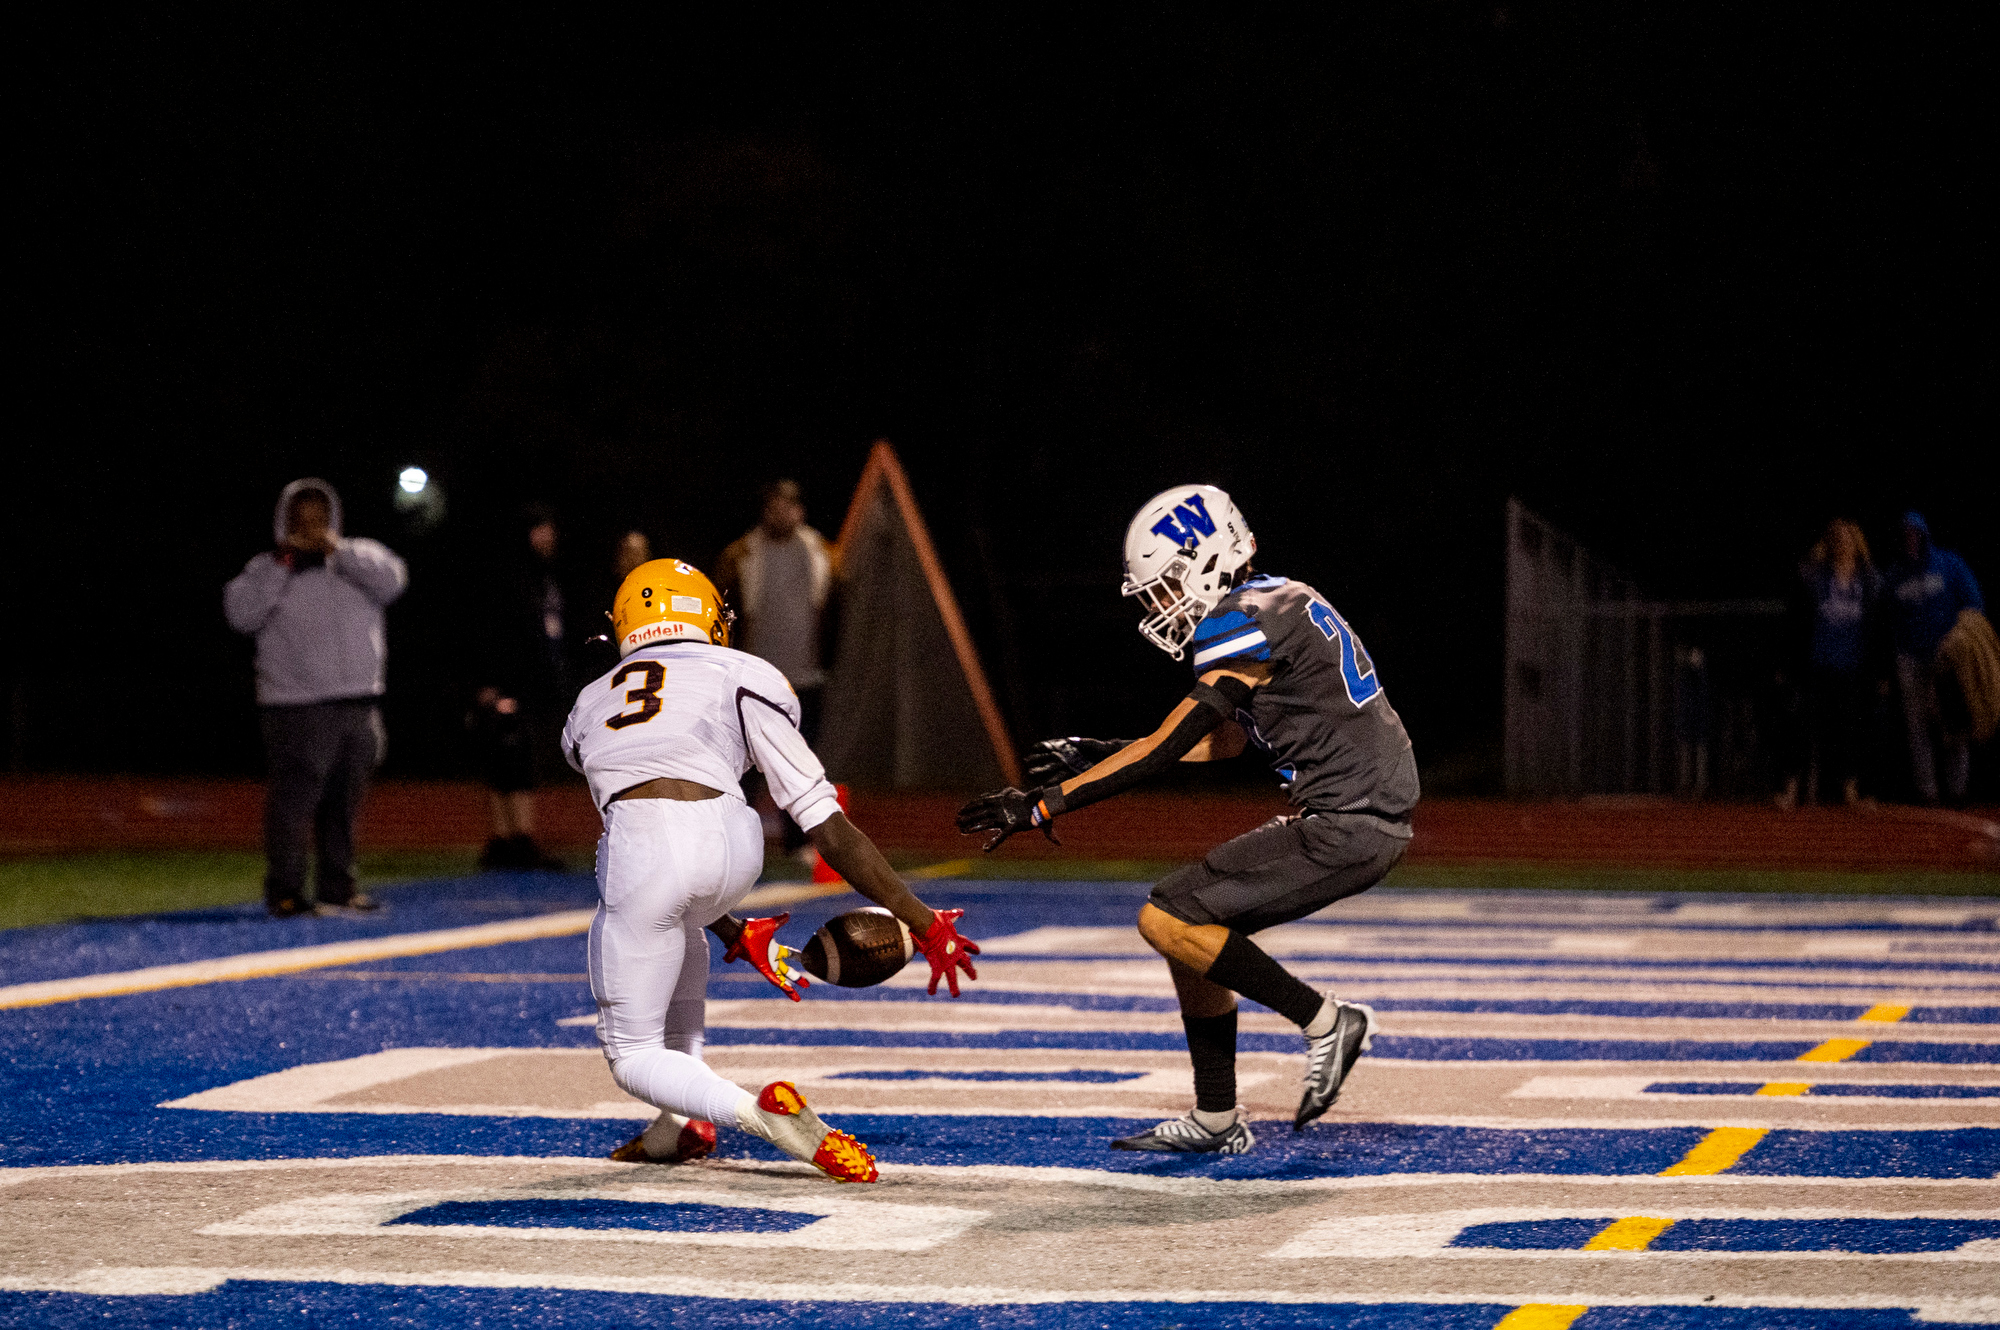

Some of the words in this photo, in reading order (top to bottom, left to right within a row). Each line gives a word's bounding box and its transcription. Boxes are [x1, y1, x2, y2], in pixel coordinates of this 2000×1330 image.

[1150, 493, 1217, 549] W
[628, 624, 684, 645] Riddell
[1304, 597, 1384, 709] 2
[605, 660, 667, 732] 3
